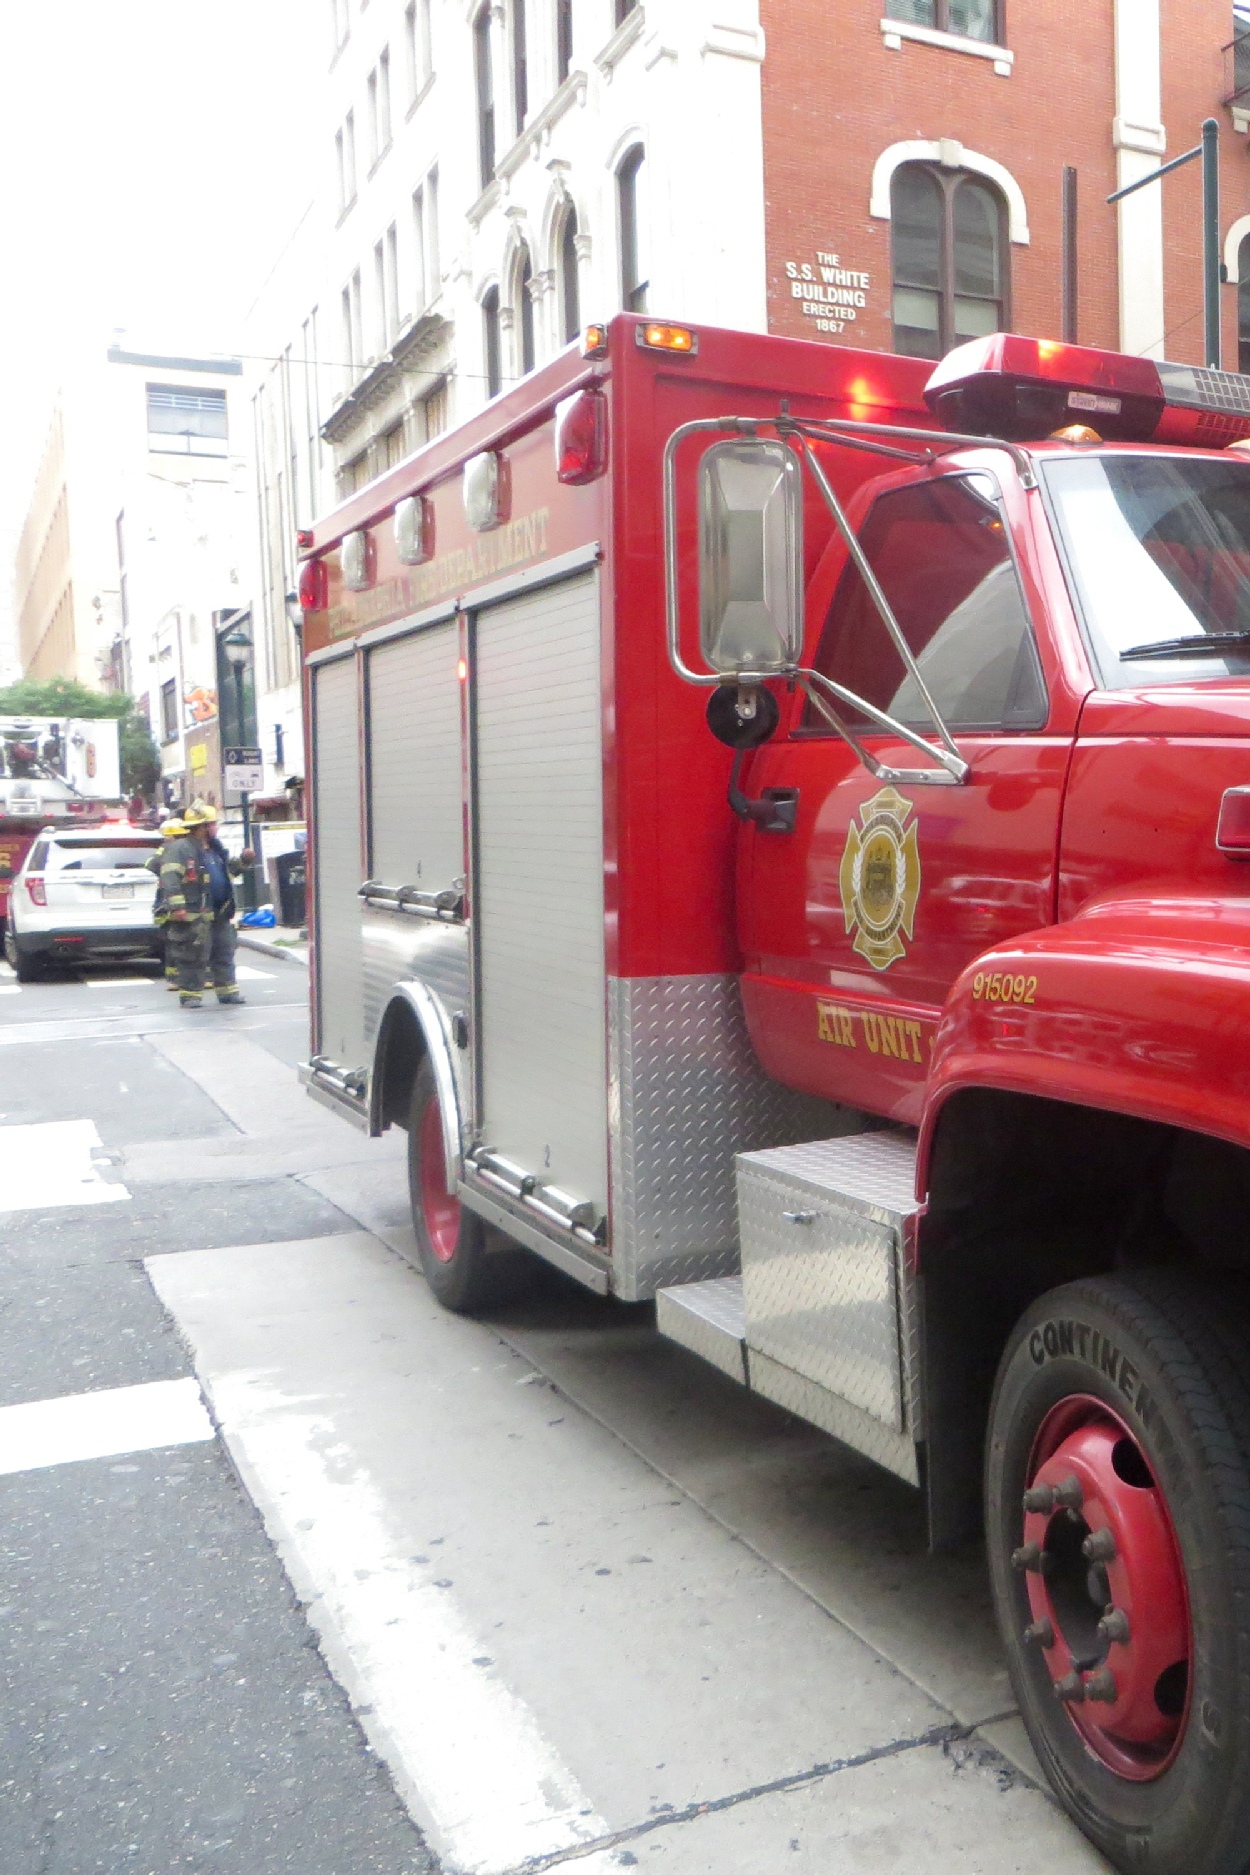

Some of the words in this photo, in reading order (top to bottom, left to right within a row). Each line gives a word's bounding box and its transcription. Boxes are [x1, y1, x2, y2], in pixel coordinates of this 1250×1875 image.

[817, 252, 839, 266] THE
[786, 261, 816, 281] S.S.
[820, 267, 870, 289] WHITE
[791, 282, 866, 307] BUILDING
[803, 302, 856, 320] ERECTED
[816, 319, 845, 333] 1867
[972, 972, 1038, 1003] 915092
[817, 1001, 856, 1047] AIR
[860, 1011, 922, 1063] UNIT
